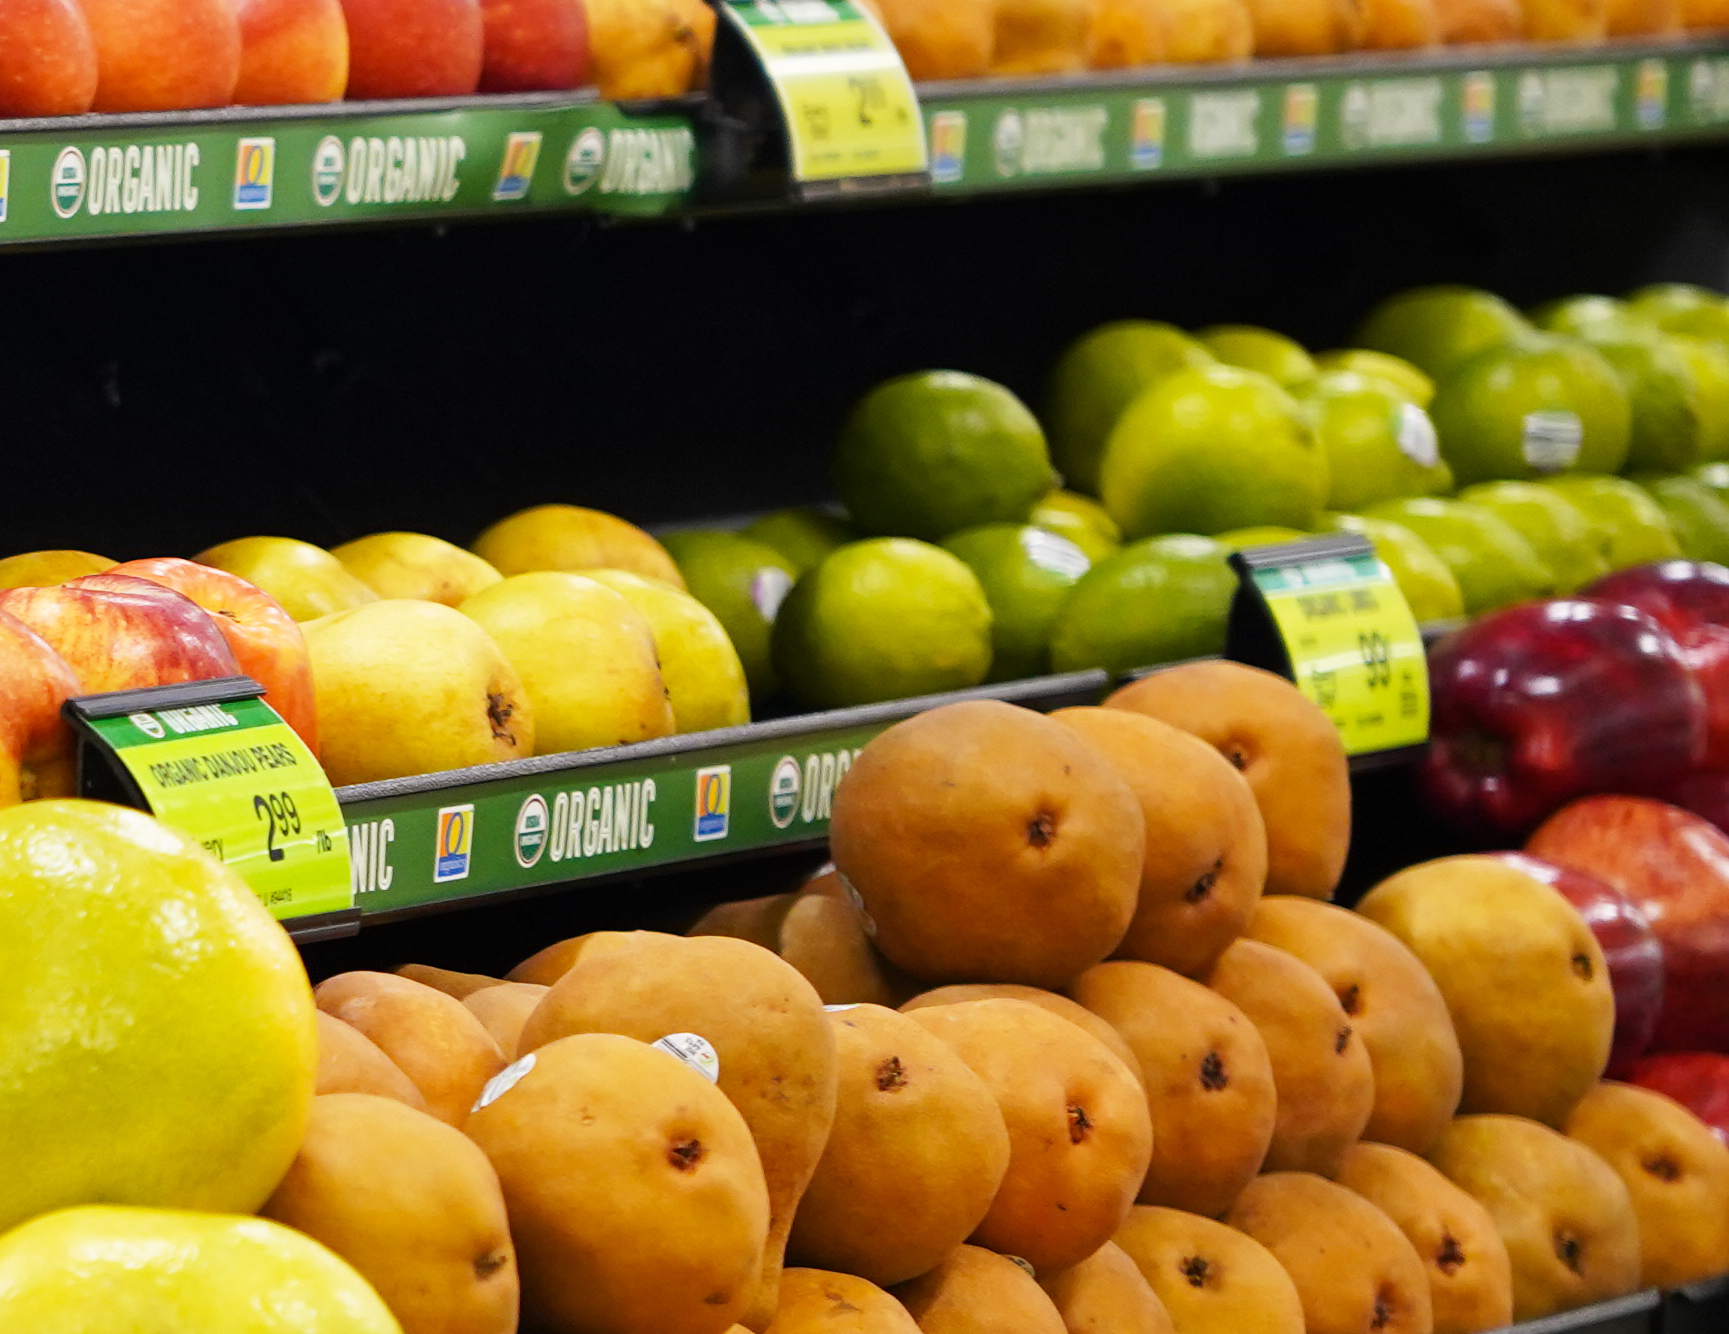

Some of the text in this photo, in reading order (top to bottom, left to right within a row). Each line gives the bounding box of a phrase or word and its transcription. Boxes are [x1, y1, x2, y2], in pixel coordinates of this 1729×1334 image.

[87, 142, 199, 216] ORGANIC
[345, 135, 465, 205] ORGANIC
[149, 757, 207, 788] ORGANIC
[251, 742, 297, 770] PEARS
[549, 778, 656, 862] ORGANIC
